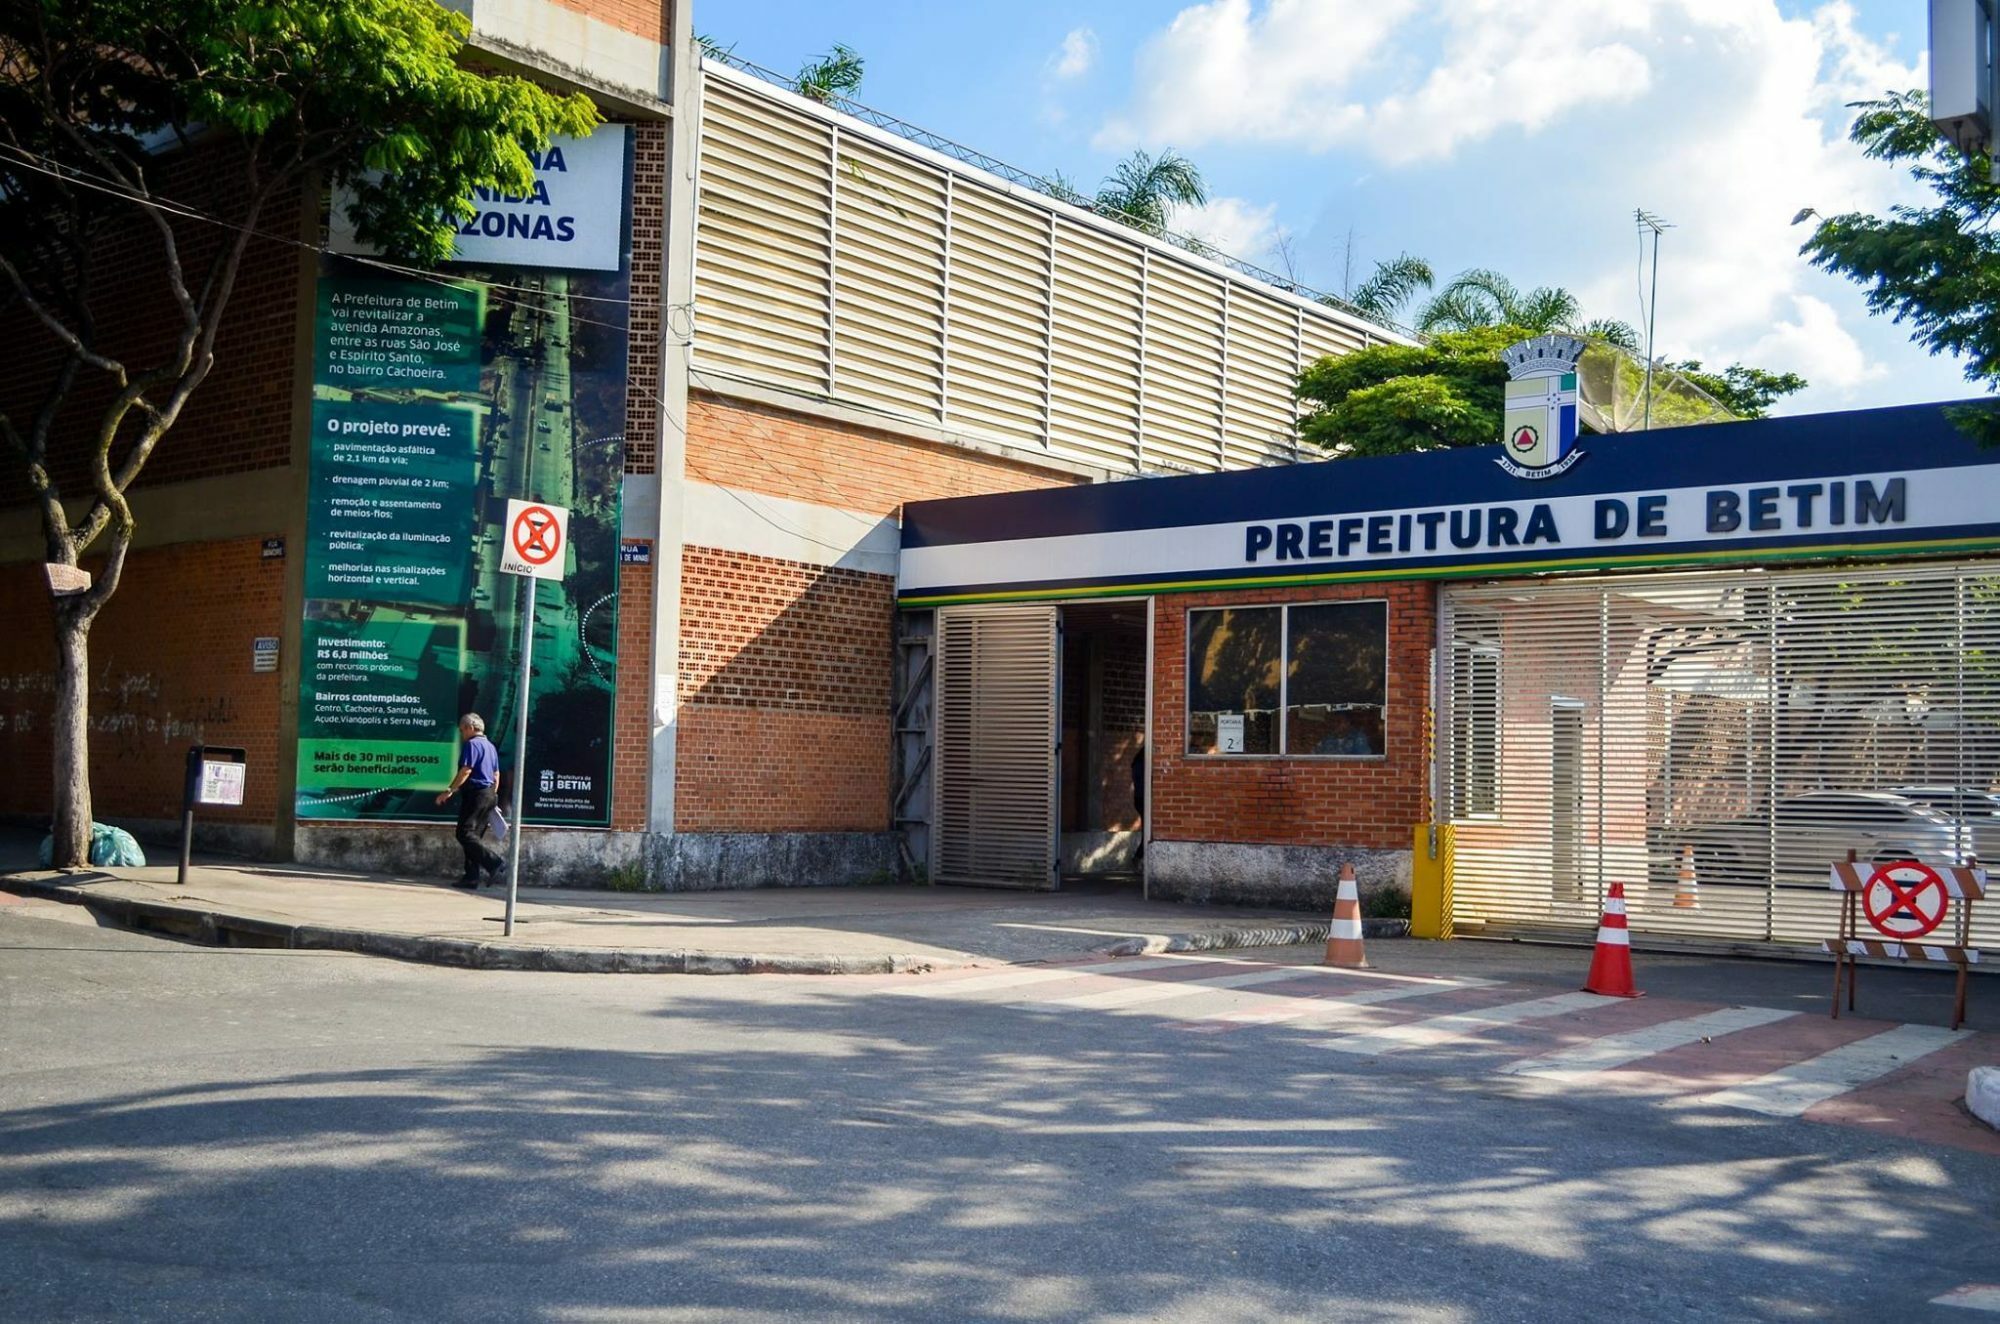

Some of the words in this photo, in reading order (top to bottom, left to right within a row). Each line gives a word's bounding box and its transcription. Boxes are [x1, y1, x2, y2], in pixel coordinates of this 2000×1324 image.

[440, 211, 574, 242] AZONAS
[332, 293, 341, 304] A
[344, 294, 403, 307] Prefeitura
[406, 297, 420, 308] de
[425, 298, 458, 310] Betim
[331, 308, 349, 318] vai
[353, 308, 414, 321] revitalizar
[417, 314, 424, 322] a
[331, 322, 377, 333] avenida
[380, 324, 444, 338] Amazonas,
[330, 336, 361, 346] entre
[365, 338, 377, 347] as
[381, 339, 406, 349] ruas
[410, 338, 430, 350] São
[434, 338, 460, 352] José
[330, 351, 336, 360] e
[340, 350, 386, 362] Espírito
[389, 352, 425, 364] Santo,
[329, 364, 344, 374] no
[348, 364, 384, 376] bairro
[386, 366, 447, 379] Cachoeira.
[328, 419, 339, 432] O
[343, 420, 399, 434] projeto
[402, 424, 451, 437] prevê:
[334, 443, 397, 453] pavimentação
[398, 444, 436, 455] asfáltica
[333, 454, 345, 462] de
[347, 454, 360, 463] 2,1
[362, 455, 376, 463] km
[379, 456, 390, 464] da
[392, 456, 408, 465] via;
[1502, 461, 1516, 473] 1711
[1526, 469, 1551, 478] BETIM
[332, 475, 377, 487] drenagem
[378, 476, 409, 487] pluvial
[411, 478, 423, 487] de
[425, 479, 431, 487] 2
[432, 479, 449, 489] km;
[332, 498, 369, 508] remoção
[380, 500, 442, 510] assentamento
[331, 508, 342, 517] de
[1246, 504, 1560, 562] PREFEITURA
[1594, 495, 1667, 540] DE
[1706, 478, 1906, 533] BETIM
[330, 531, 387, 541] revitalização
[389, 532, 400, 540] da
[402, 533, 451, 543] iluminação
[329, 540, 364, 551] pública;
[329, 563, 373, 573] melhorias
[392, 565, 446, 576] sinalizações
[504, 562, 533, 573] INÍCIO
[328, 574, 374, 583] horizontal
[384, 575, 420, 586] vertical.
[318, 637, 386, 648] Investimento:
[317, 650, 330, 659] R$
[332, 650, 348, 660] 6,8
[350, 650, 389, 660] milhões
[370, 664, 403, 674] próprios
[316, 672, 326, 680] da
[328, 672, 369, 683] prefeitura.
[315, 692, 350, 701] Bairros
[352, 694, 420, 704] contemplados:
[315, 704, 342, 713] Centro,
[344, 704, 385, 714] Cachoeira,
[387, 706, 409, 714] Santa
[390, 717, 411, 725] Serra
[412, 717, 436, 727] Negra
[1228, 738, 1234, 749] 2
[314, 751, 340, 761] Mais
[343, 752, 356, 761] de
[359, 752, 373, 762] 30
[376, 753, 393, 762] mil
[396, 755, 439, 764] pessoas
[314, 763, 344, 773] serão
[557, 780, 591, 790] BETIM
